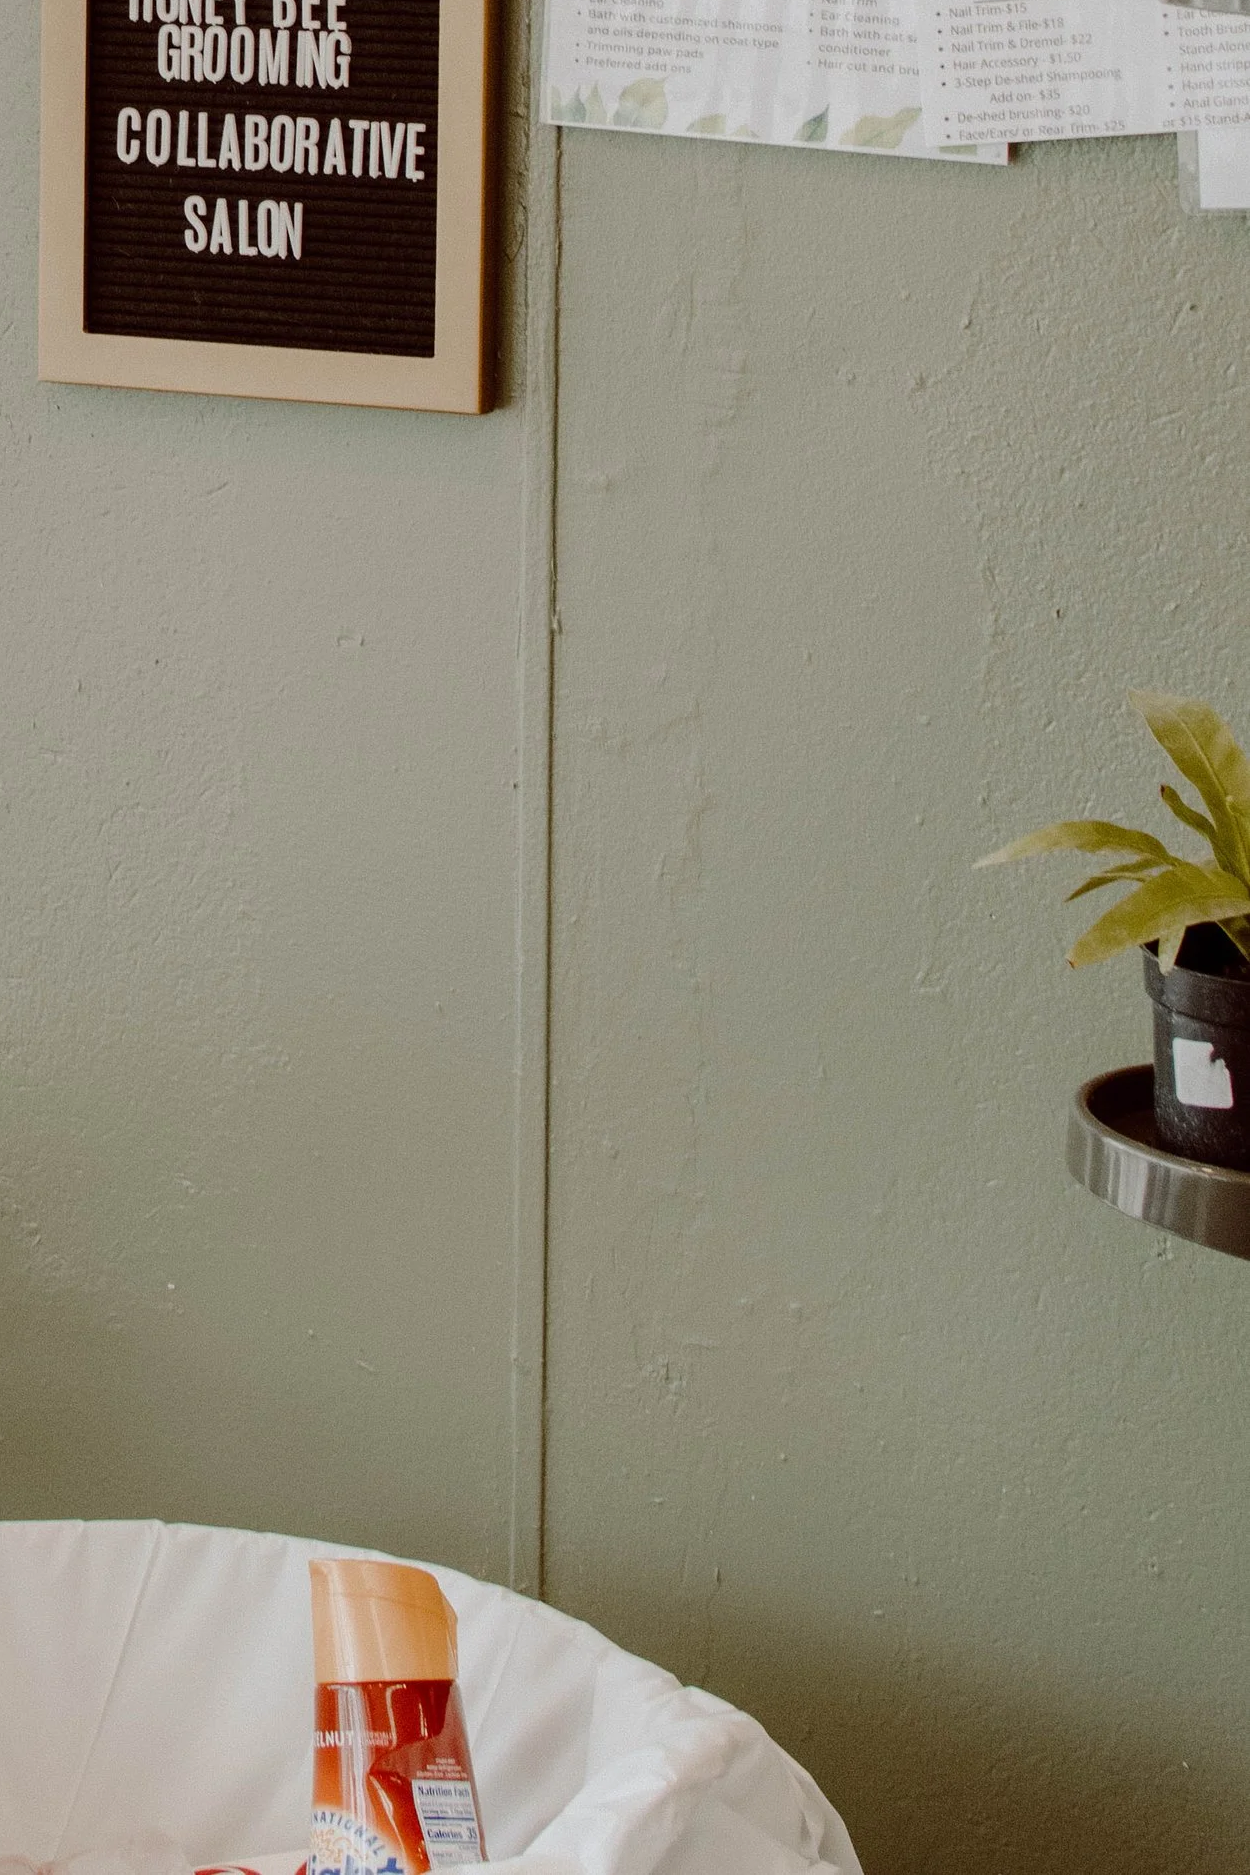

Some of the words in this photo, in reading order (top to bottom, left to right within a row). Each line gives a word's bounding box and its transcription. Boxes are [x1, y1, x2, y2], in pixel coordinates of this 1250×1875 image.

[949, 7, 972, 18] Nail
[951, 24, 973, 35] Nail
[977, 22, 1004, 33] Trim
[1007, 21, 1015, 31] &
[1178, 25, 1213, 38] Tooth
[952, 42, 974, 53] Nail
[978, 40, 1005, 51] Trim
[1008, 39, 1016, 49] &
[1071, 34, 1093, 48] $22
[157, 24, 352, 89] GROOMING
[980, 55, 1038, 71] Accessory
[954, 76, 991, 91] 3-Step
[995, 72, 1043, 85] De-shed
[990, 92, 1013, 103] Add
[957, 110, 1005, 123] De-shed
[1069, 105, 1090, 119] $20
[1039, 125, 1066, 136] Rear
[117, 107, 426, 182] COLLABORATIVE
[184, 195, 303, 260] SALON
[427, 1830, 462, 1839] Calories
[467, 1827, 477, 1839] 35
